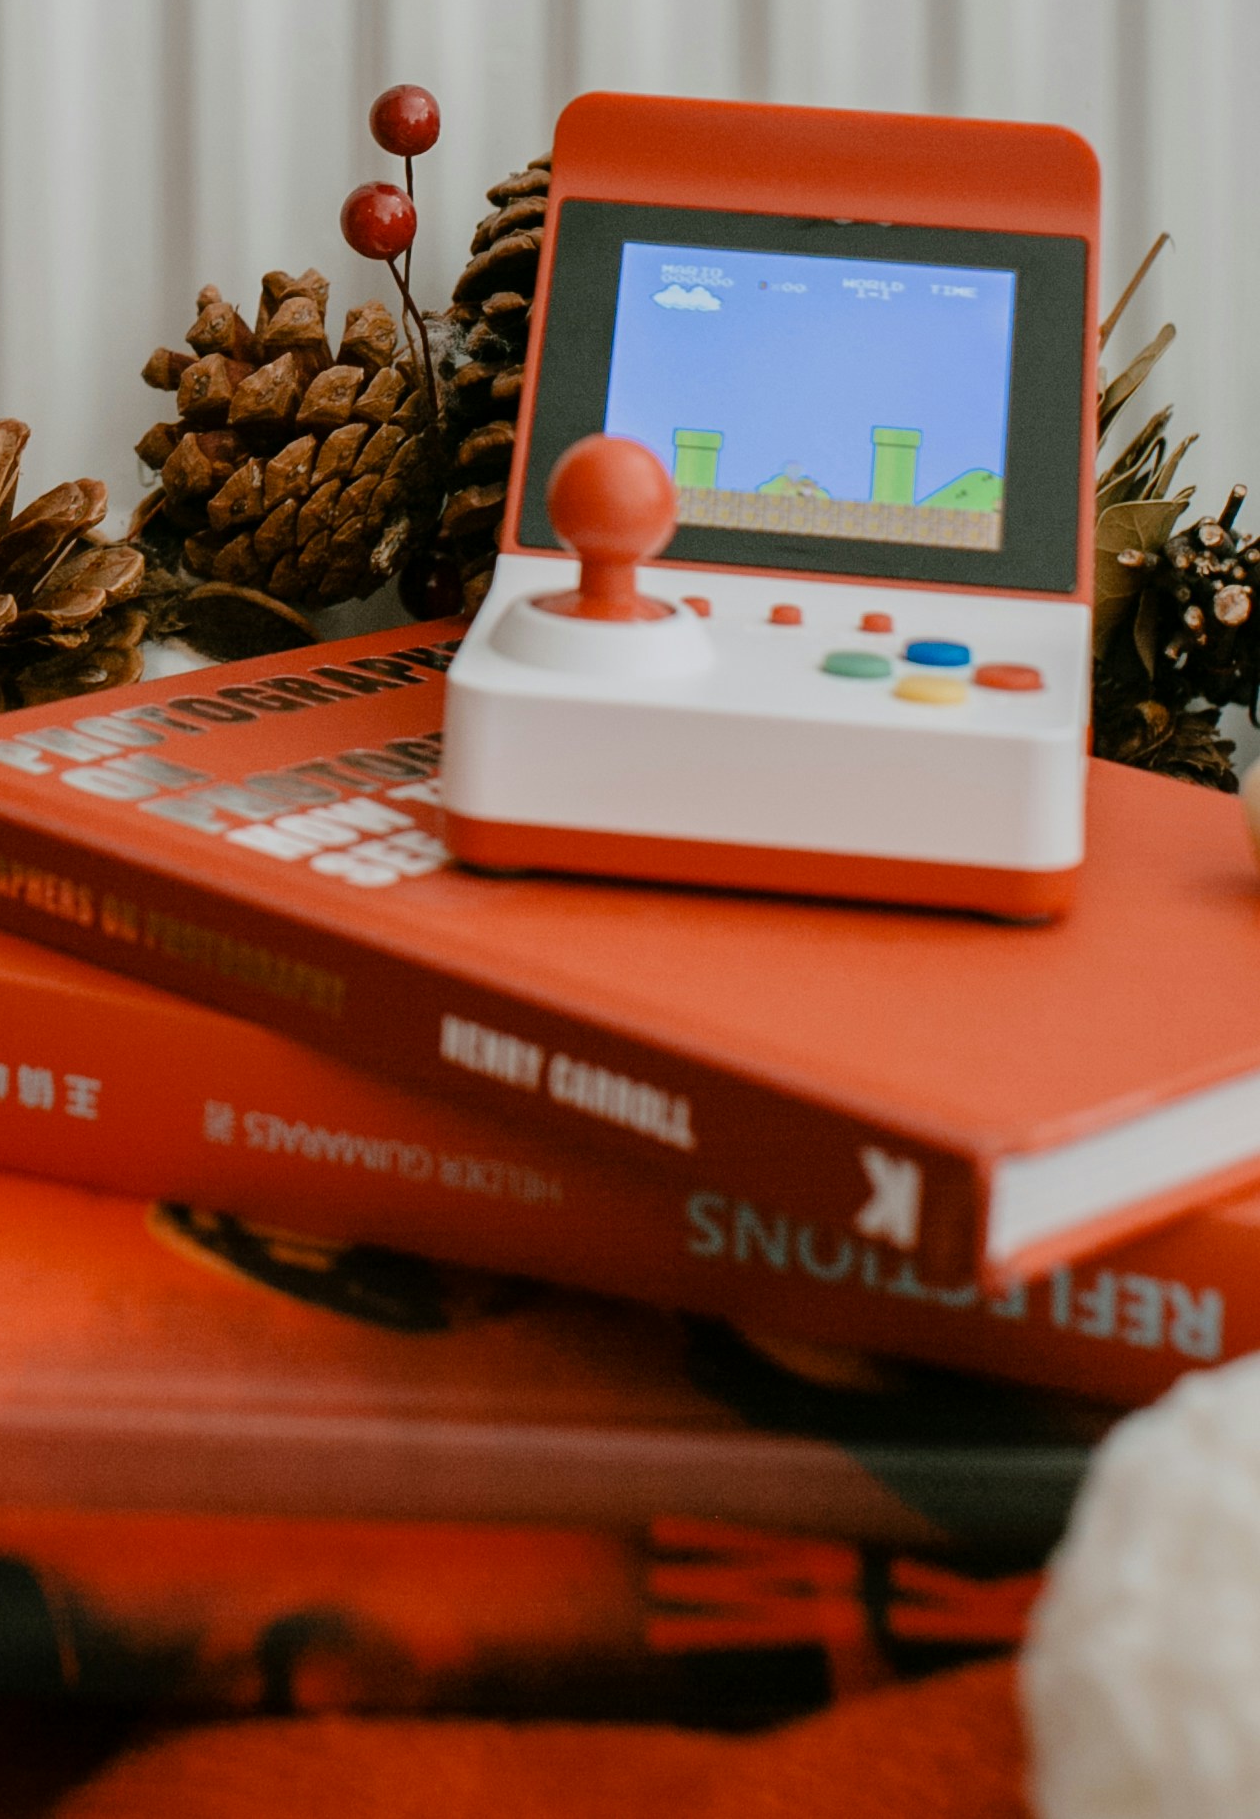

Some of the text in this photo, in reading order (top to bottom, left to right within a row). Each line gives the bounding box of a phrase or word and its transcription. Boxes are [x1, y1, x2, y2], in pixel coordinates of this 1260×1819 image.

[661, 264, 723, 278] MARIO
[842, 277, 906, 294] WORLD
[930, 283, 978, 299] TIME
[60, 752, 212, 801] ON
[226, 796, 416, 862] HOW
